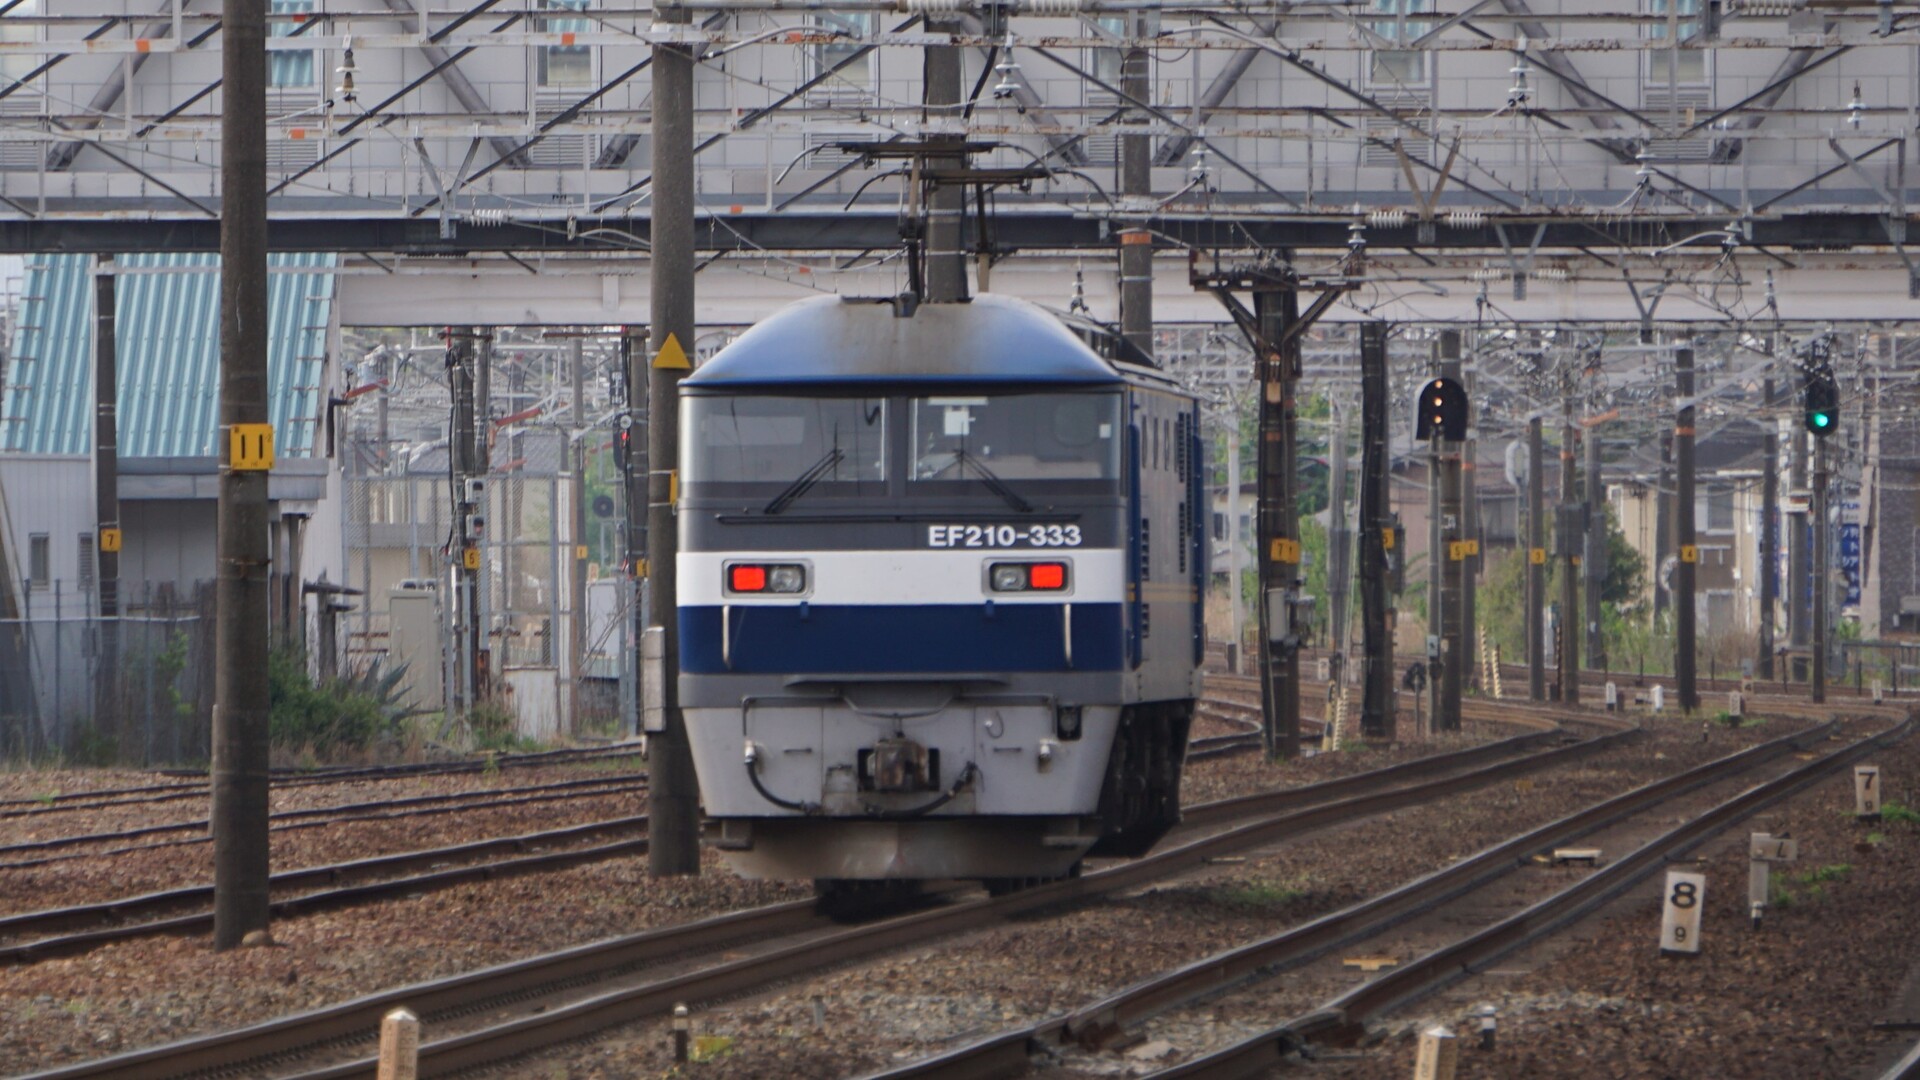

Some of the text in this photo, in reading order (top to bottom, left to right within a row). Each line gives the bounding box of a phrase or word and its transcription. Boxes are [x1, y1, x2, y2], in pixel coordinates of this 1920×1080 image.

[241, 433, 263, 460] 11
[107, 534, 114, 547] 7
[928, 525, 1082, 547] EF210-333
[1858, 771, 1877, 791] 7
[1671, 882, 1697, 910] 8
[1674, 926, 1687, 943] 9
